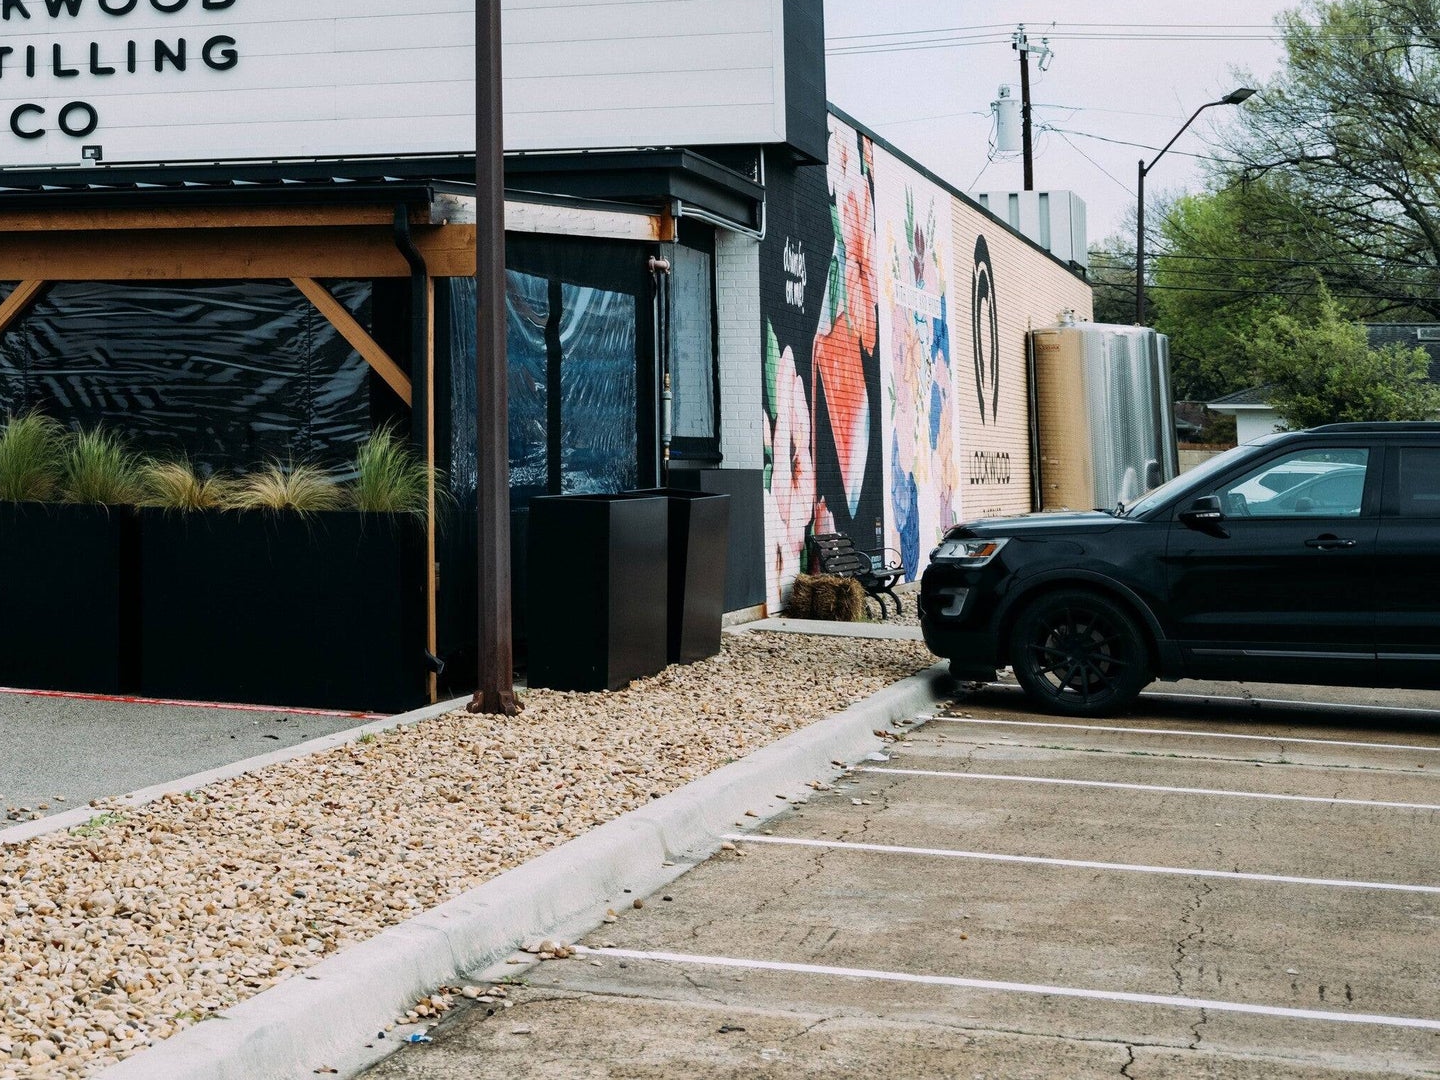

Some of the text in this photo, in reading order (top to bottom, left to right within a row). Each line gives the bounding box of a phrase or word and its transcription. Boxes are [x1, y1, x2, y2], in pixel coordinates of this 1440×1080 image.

[9, 100, 99, 140] CO
[783, 235, 807, 287] drinks
[969, 450, 1011, 485] LOCKWOOD
